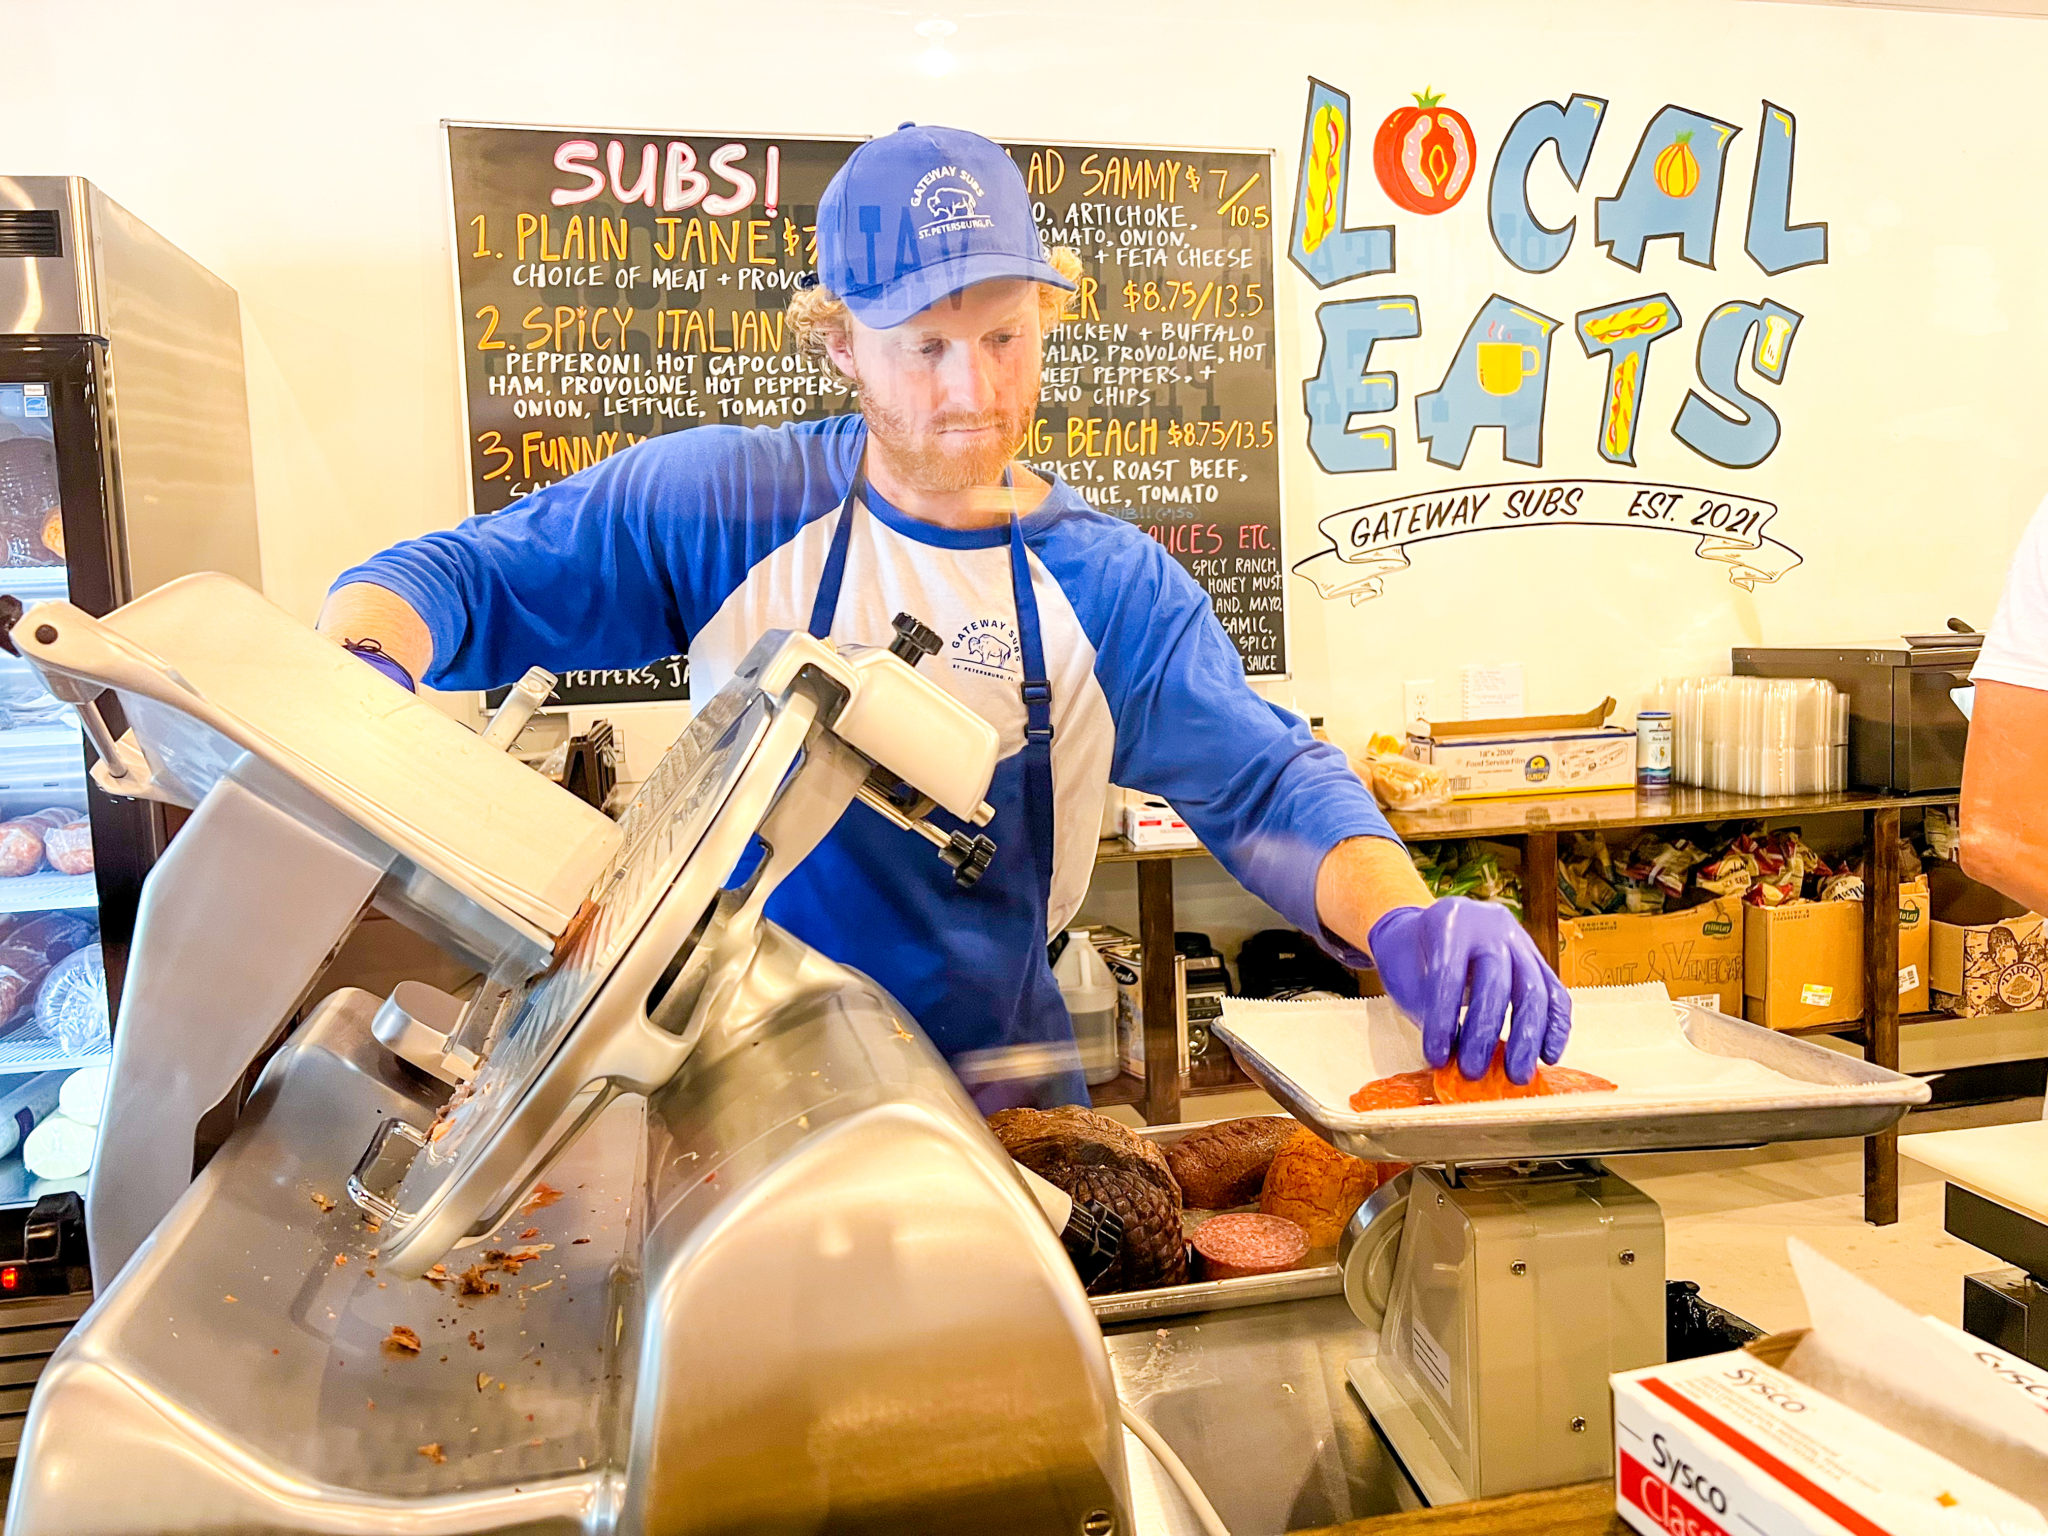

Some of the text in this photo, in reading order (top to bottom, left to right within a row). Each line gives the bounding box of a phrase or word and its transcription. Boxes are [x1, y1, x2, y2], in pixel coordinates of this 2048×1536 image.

[550, 139, 780, 218] SUBS!
[911, 166, 984, 206] GATEWAY SUBS
[1008, 148, 1065, 195] AD
[1080, 153, 1181, 203] SAMMY
[1065, 203, 1198, 230] ARTICHOKE,
[516, 213, 628, 263] PLAIN
[654, 217, 776, 265] JANE
[1035, 226, 1190, 249] OMATO, ONION,
[1116, 249, 1168, 268] FETA
[1177, 249, 1253, 269] CHEESE
[513, 264, 604, 289] CHOICE
[615, 267, 640, 289] OF
[653, 268, 708, 293] MEAT
[738, 268, 814, 292] PROVO
[1122, 279, 1264, 321] $8.75/13.5
[657, 308, 784, 354] ITALIAN
[1161, 322, 1254, 341] BUFFALO
[506, 351, 821, 377] PEPPERONI, HOT CAPOCOLL
[1042, 343, 1266, 365] ALAD, PROVOLONE, HOT
[705, 376, 744, 395] HOT
[1093, 366, 1192, 385] PEPPERS,
[1302, 293, 1804, 475] EATS
[513, 399, 591, 419] ONION,
[717, 397, 807, 417] TOMATO
[1093, 387, 1151, 407] CHIPS
[1067, 417, 1158, 458] BEACH
[1167, 420, 1274, 451] $8.75/13.5
[522, 430, 619, 479] FUNNY
[1017, 458, 1248, 482] RKEY, ROAST BEEF,
[1070, 484, 1218, 508] TUCE, TOMATO
[1350, 488, 1584, 547] GATEWAY SUBS
[1628, 490, 1760, 536] EST. 2021
[1137, 524, 1276, 554] AUCES ETC.
[1192, 558, 1227, 576] SPICY
[1208, 576, 1246, 594] HONEY
[1212, 596, 1243, 614] AND.
[952, 619, 1006, 649] GATEWAY
[1239, 636, 1277, 652] SPICY
[1247, 655, 1277, 671] SAUCE
[2003, 966, 2039, 983] DIRTY
[1723, 1368, 1806, 1413] Sysco
[1653, 1433, 1727, 1515] Sysco
